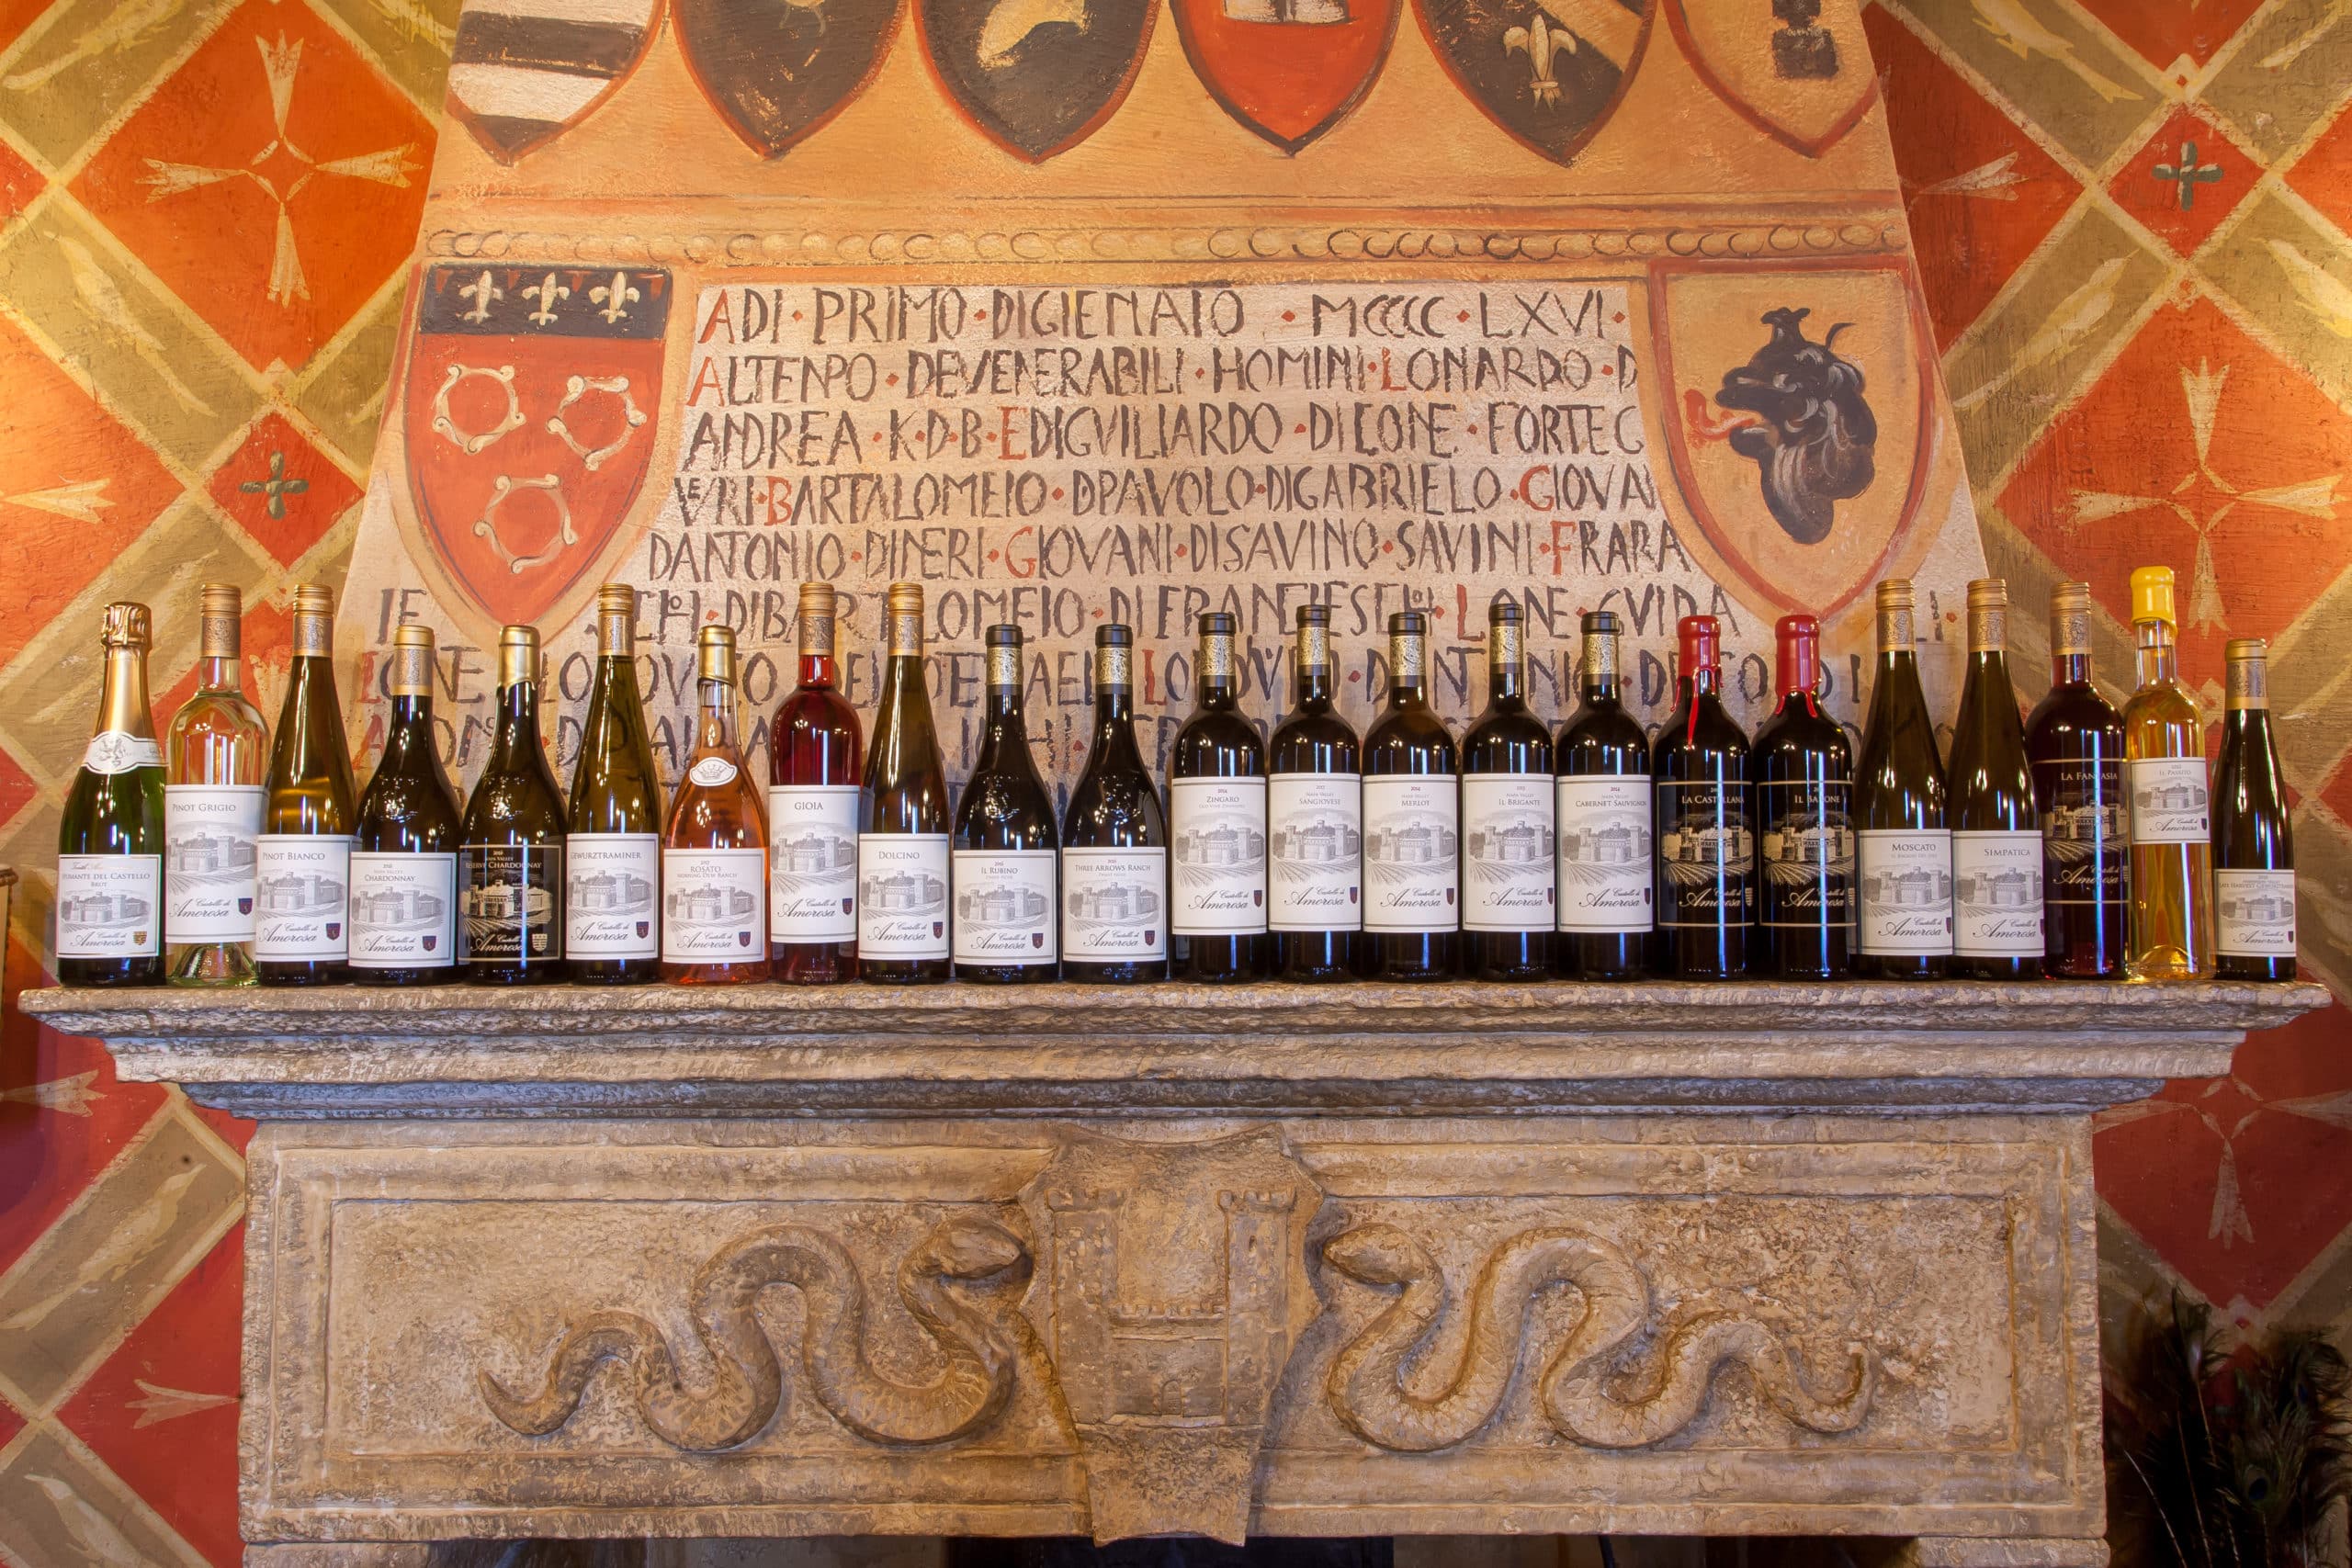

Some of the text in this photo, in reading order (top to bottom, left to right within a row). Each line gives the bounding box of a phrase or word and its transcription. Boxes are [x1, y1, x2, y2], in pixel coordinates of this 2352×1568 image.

[813, 286, 967, 344] PRIMO
[682, 410, 863, 471] ANDREA
[198, 804, 236, 812] GRIGIO
[795, 802, 823, 810] GIOIA
[1682, 795, 1692, 804] LA
[1188, 890, 1248, 909] Amorosa
[1284, 886, 1344, 906] Amorosa
[1381, 888, 1441, 908] Amorosa
[1483, 888, 1543, 907] Amorosa
[1579, 889, 1639, 908] Amorosa
[169, 898, 229, 918] Amorosa
[777, 898, 835, 918] Amorosa
[259, 923, 318, 942] Amorosa
[571, 921, 628, 941] Amorosa
[867, 921, 926, 941] Amorosa
[1878, 918, 1941, 937] Amorosa
[1973, 919, 2036, 938] Amorosa
[677, 931, 731, 949] Amorosa
[971, 933, 1025, 950] Amorosa
[1083, 931, 1138, 947] Amorosa
